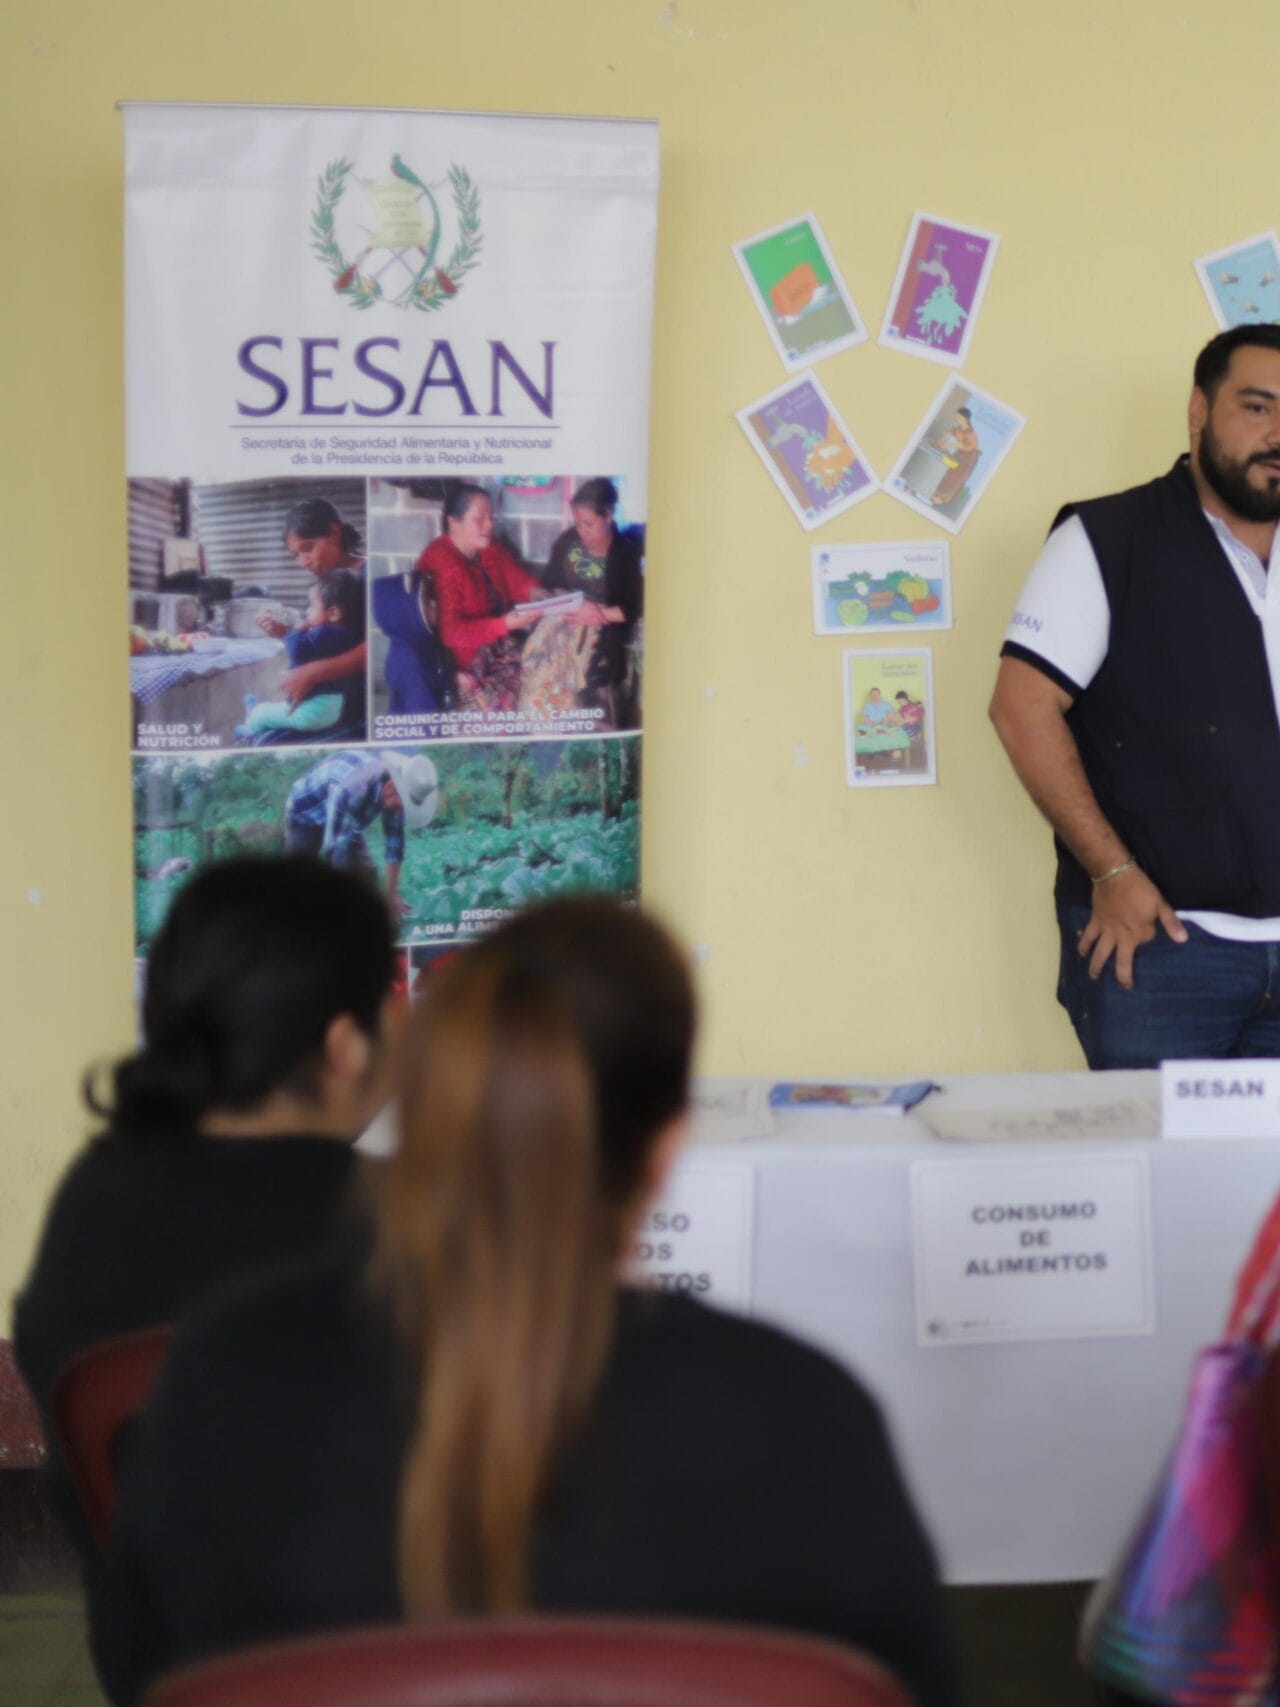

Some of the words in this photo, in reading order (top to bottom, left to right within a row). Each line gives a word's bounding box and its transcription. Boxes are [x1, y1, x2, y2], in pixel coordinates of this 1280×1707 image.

[236, 335, 558, 419] SESAN
[309, 437, 326, 449] de
[330, 437, 396, 450] Seguridad
[400, 437, 470, 449] Alimentaria
[473, 439, 481, 450] y
[485, 437, 552, 449] Nutricional
[291, 452, 308, 464] de
[312, 453, 323, 464] la
[327, 452, 402, 464] Presidencia
[406, 452, 421, 464] de
[425, 452, 435, 464] la
[375, 710, 483, 726] COMUNICACIÓN
[488, 711, 526, 722] PARA
[530, 710, 545, 721] EL
[551, 708, 604, 720] CAMBIO
[138, 723, 188, 735] SALUD
[193, 723, 203, 734] Y
[376, 726, 426, 738] SOCIAL
[429, 726, 438, 736] Y
[441, 725, 459, 736] DE
[463, 720, 595, 734] COMPORTAMIENTO
[138, 735, 220, 747] NUTRICIÓN
[412, 925, 422, 935] A
[426, 923, 453, 934] UNA
[1176, 1080, 1265, 1098] SESAN
[971, 1201, 1097, 1224] CONSUMO
[1020, 1230, 1051, 1248] DE
[966, 1253, 1108, 1277] ALIMENTOS
